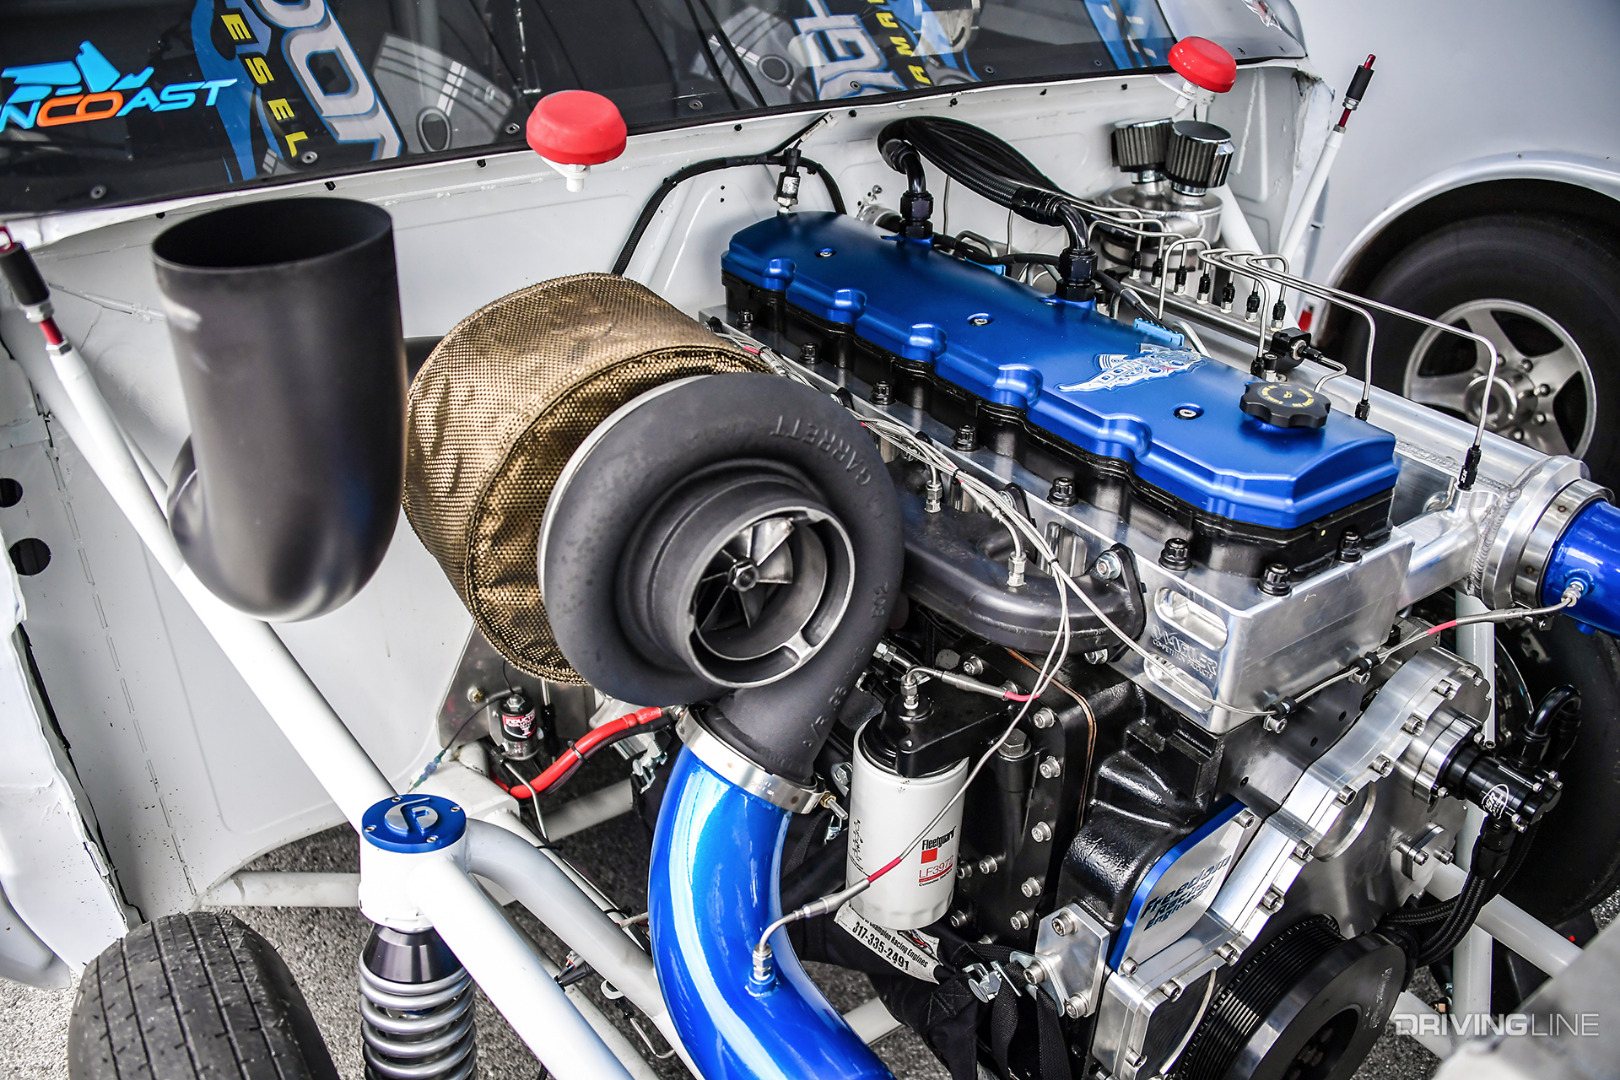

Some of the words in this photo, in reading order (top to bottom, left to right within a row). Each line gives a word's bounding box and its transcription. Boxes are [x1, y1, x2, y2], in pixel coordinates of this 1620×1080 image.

[0, 78, 238, 133] NCOAST
[769, 415, 872, 486] GARRETT
[921, 825, 957, 851] Fleetguard
[1140, 854, 1232, 920] Freedom
[852, 921, 911, 971] 317-335-2491
[890, 937, 909, 954] Racing
[907, 949, 929, 968] Engines
